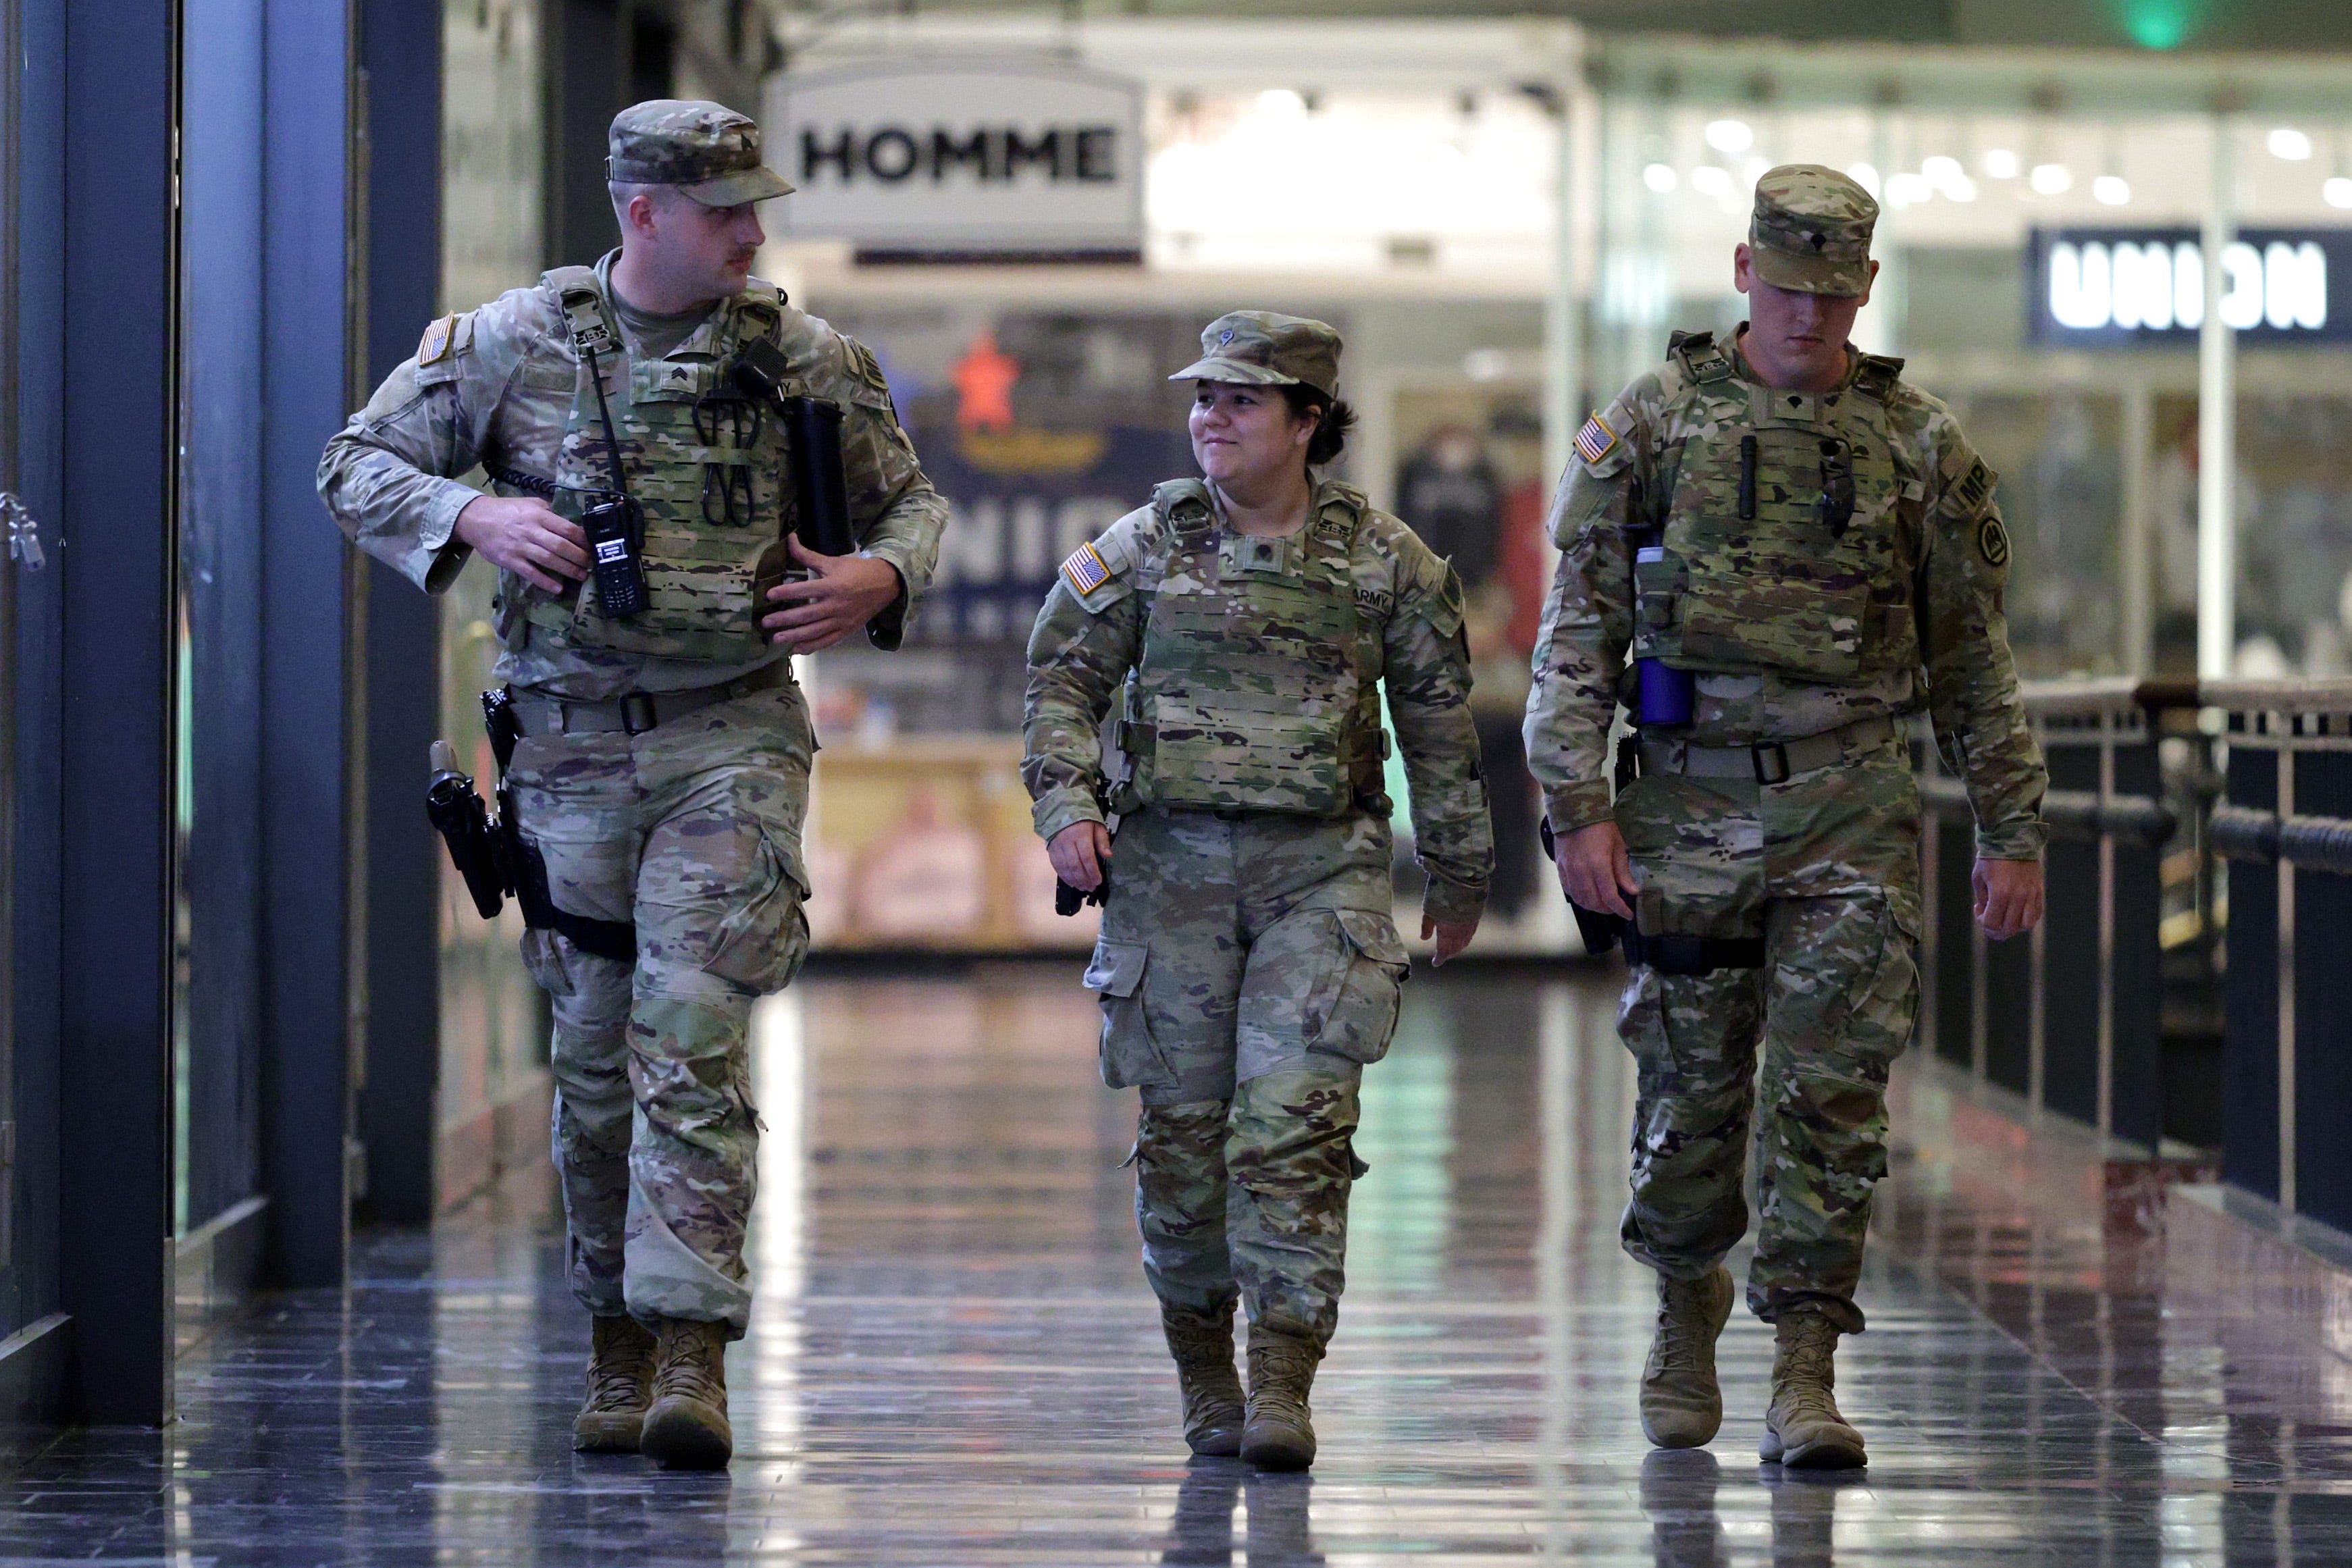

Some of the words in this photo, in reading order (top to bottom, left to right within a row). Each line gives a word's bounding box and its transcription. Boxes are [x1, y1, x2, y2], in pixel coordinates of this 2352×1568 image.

[802, 128, 1118, 181] HOMME
[1959, 464, 1987, 506] MP
[1353, 588, 1388, 608] ARMY
